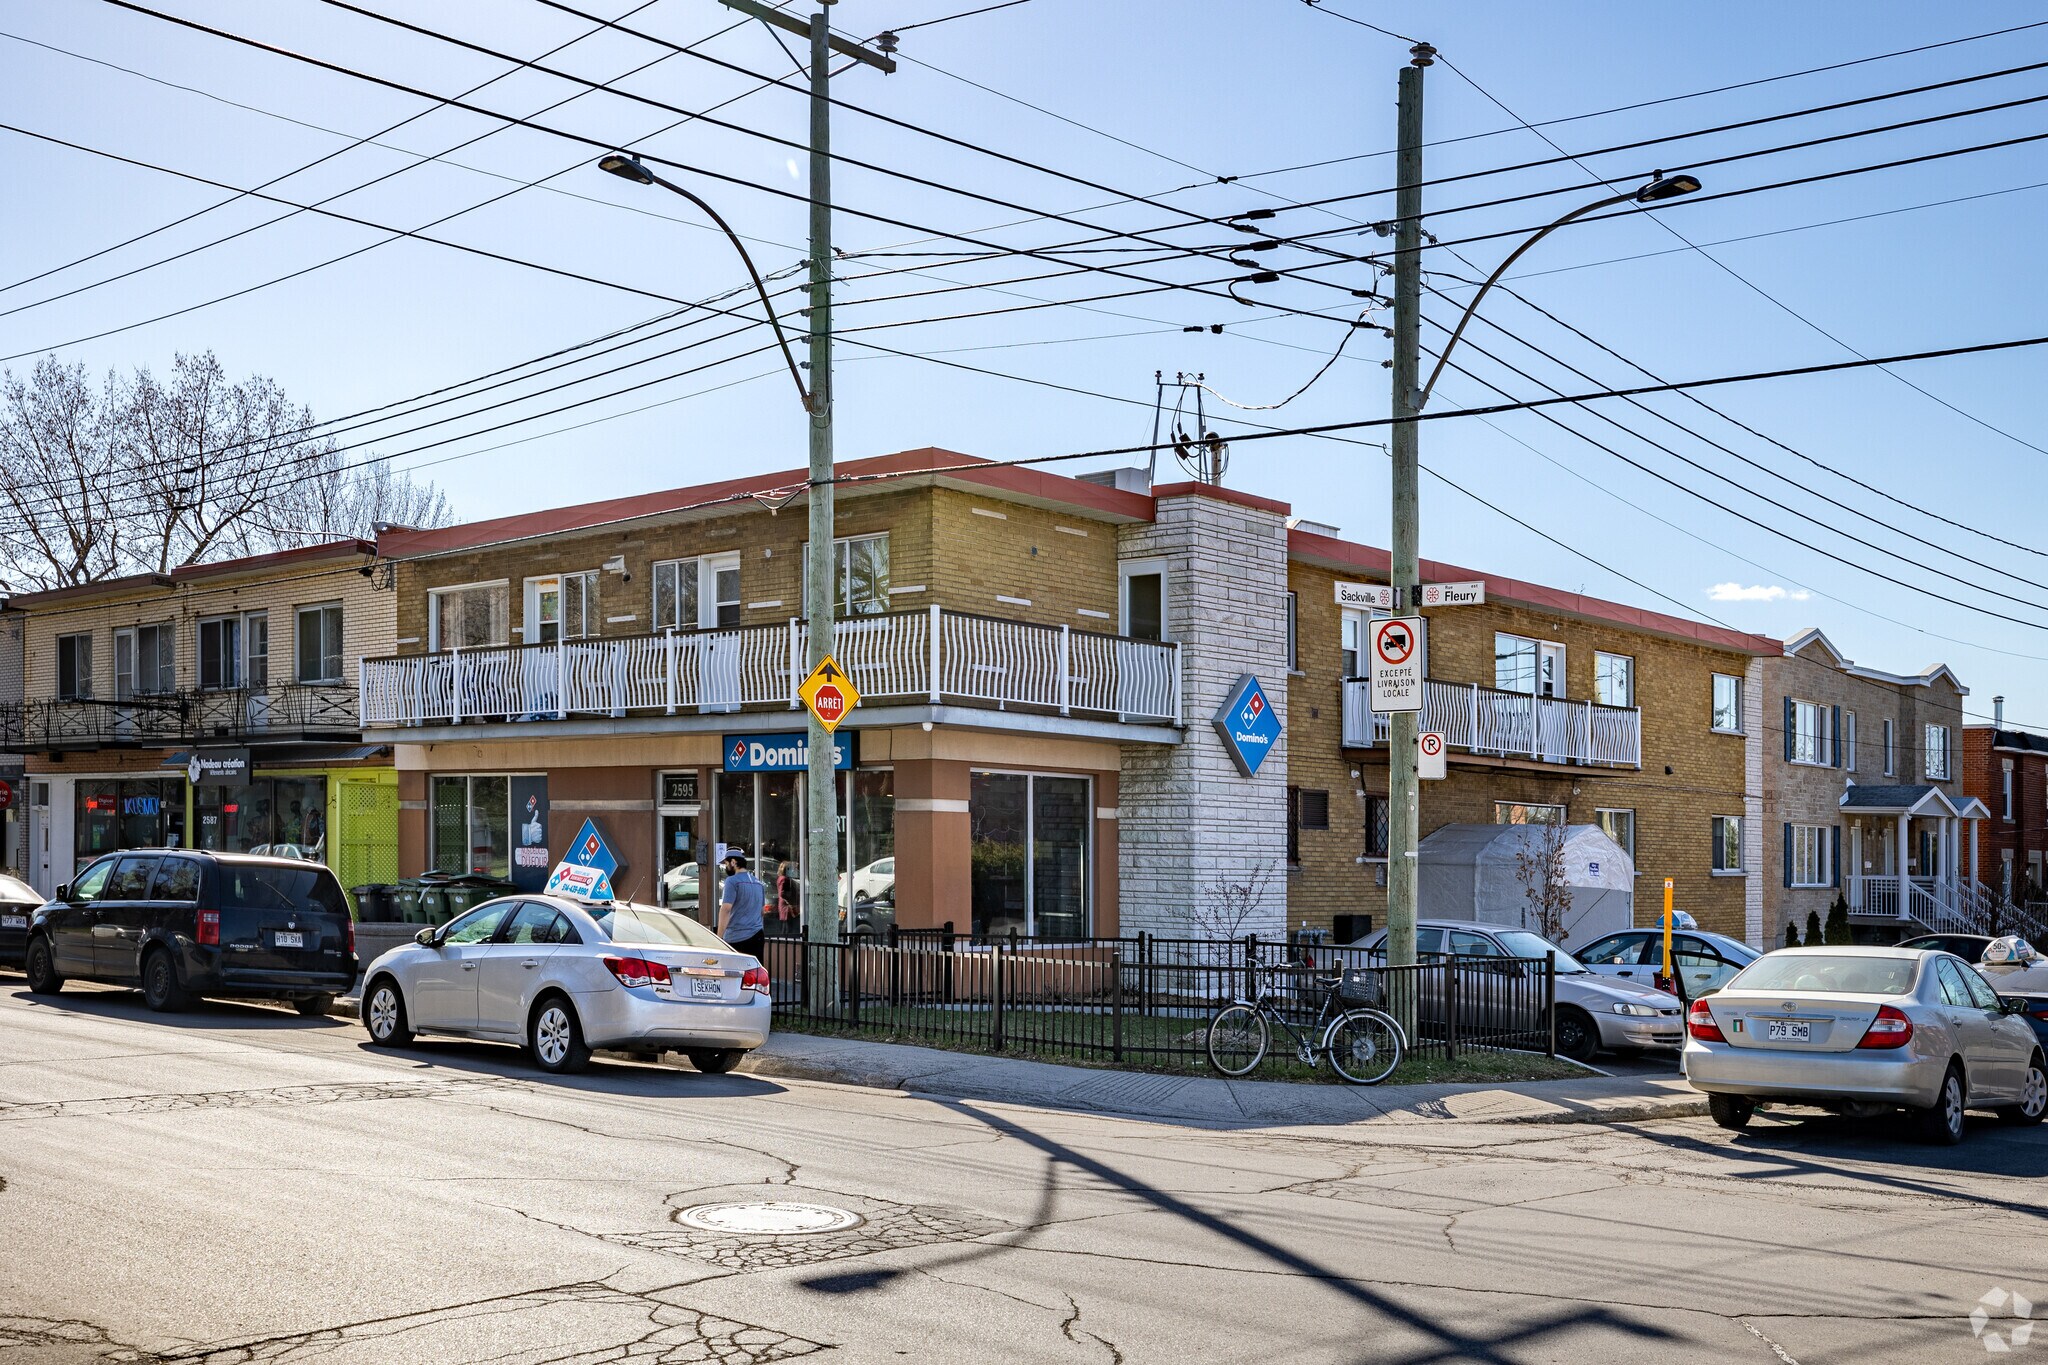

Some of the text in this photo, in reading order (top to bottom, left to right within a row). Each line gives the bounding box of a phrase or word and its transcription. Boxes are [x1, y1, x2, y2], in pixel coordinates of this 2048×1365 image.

[1341, 589, 1376, 604] Sackville
[1444, 590, 1477, 603] Fleury
[1380, 667, 1412, 678] EXCEPTÉ
[1377, 678, 1416, 688] LIVRAISON
[1383, 689, 1410, 698] LOCALE
[817, 695, 842, 710] ARRÊT
[1236, 731, 1269, 744] Domino's
[200, 758, 222, 769] Nadeau
[672, 783, 694, 797] 2595
[202, 815, 218, 825] 2587
[276, 935, 287, 943] H10
[1769, 1025, 1809, 1037] P79 SMB
